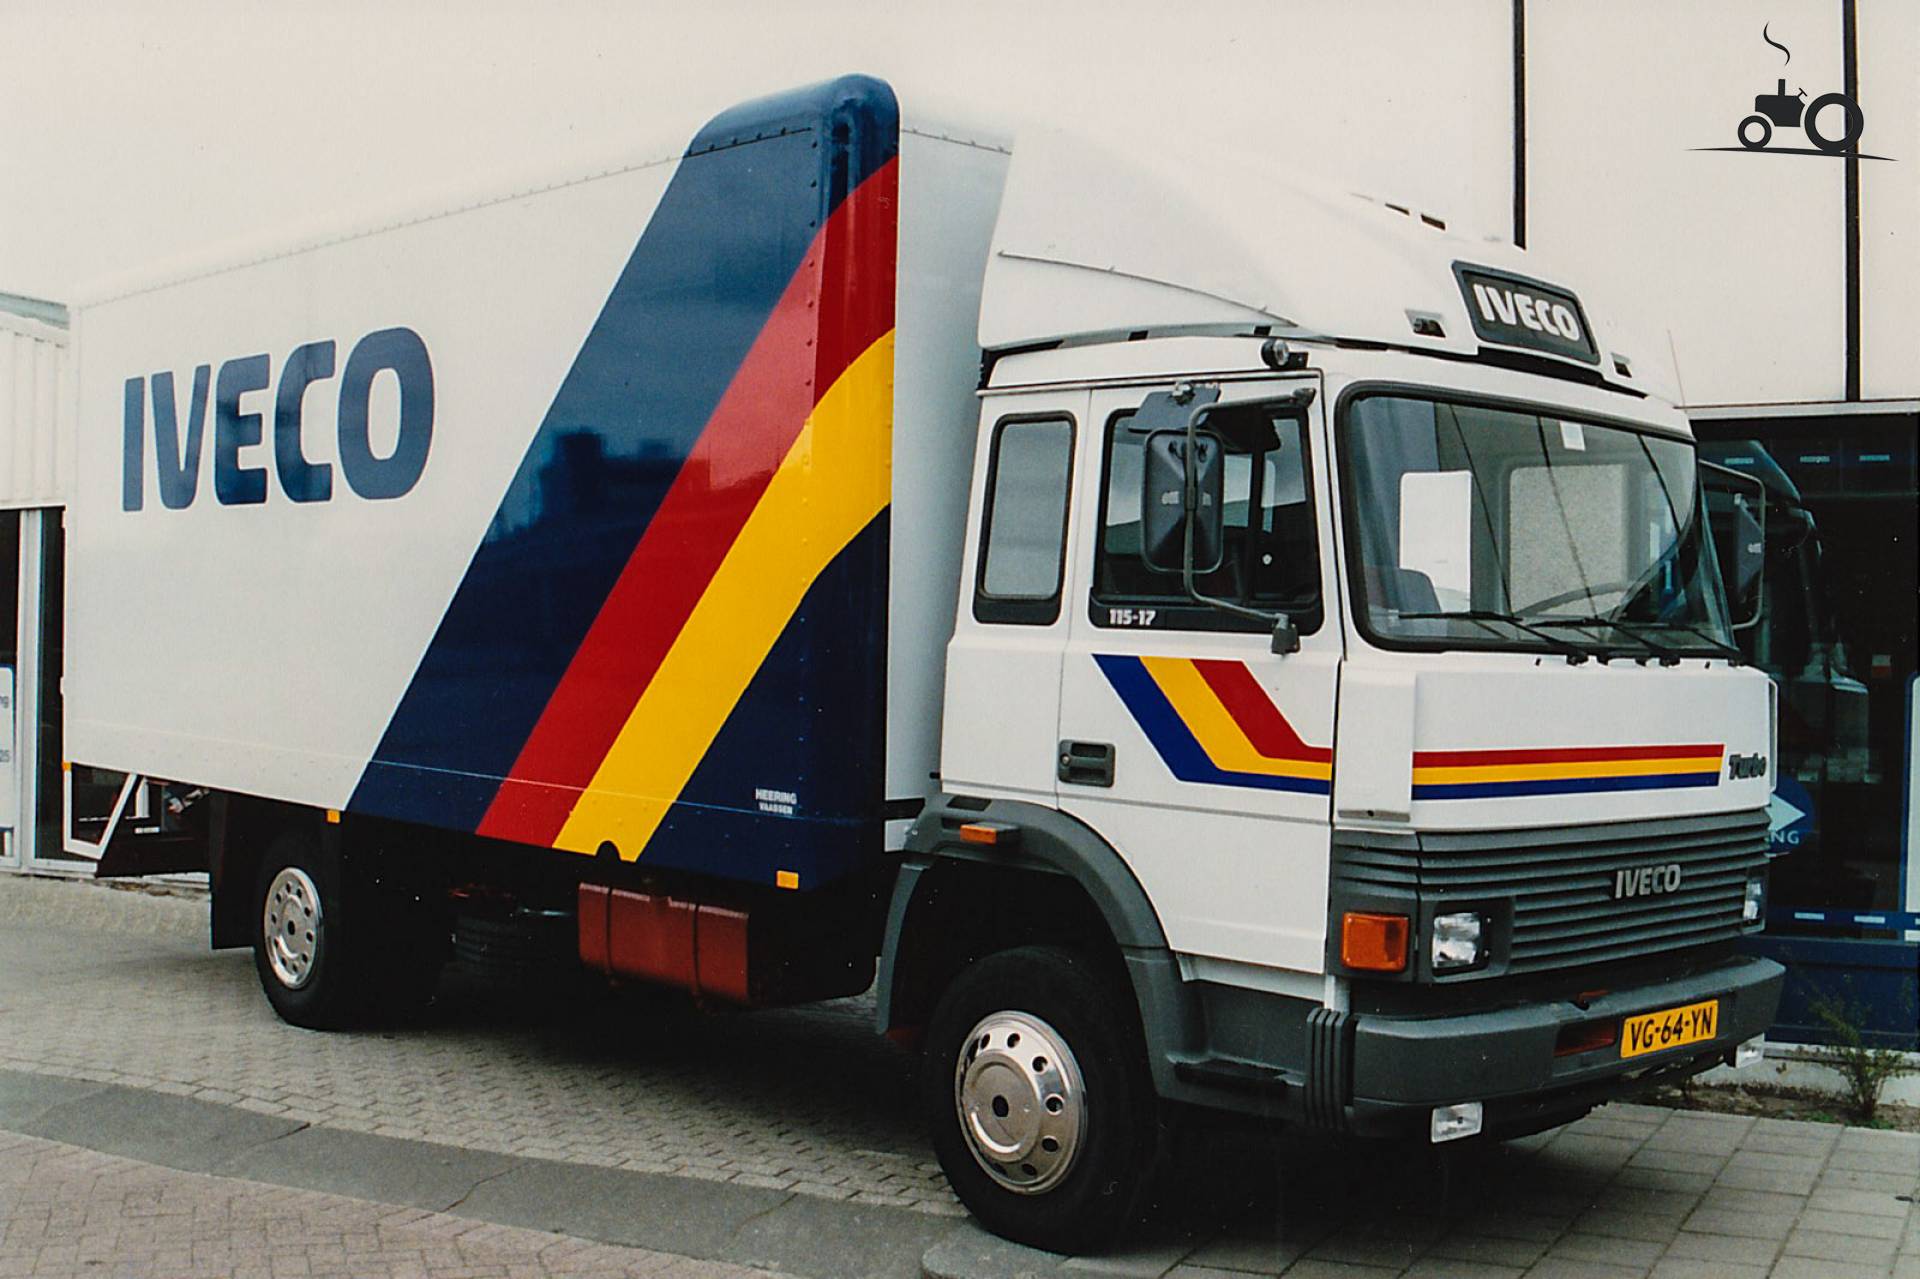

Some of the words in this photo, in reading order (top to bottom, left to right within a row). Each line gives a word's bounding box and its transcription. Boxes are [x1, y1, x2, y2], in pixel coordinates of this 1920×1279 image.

[1473, 283, 1580, 342] IVECO
[121, 326, 435, 512] IVECO
[1109, 608, 1156, 626] 115-17
[1764, 830, 1800, 845] NG
[1615, 864, 1681, 899] IVECO
[1631, 1007, 1713, 1051] VG-64-YN
